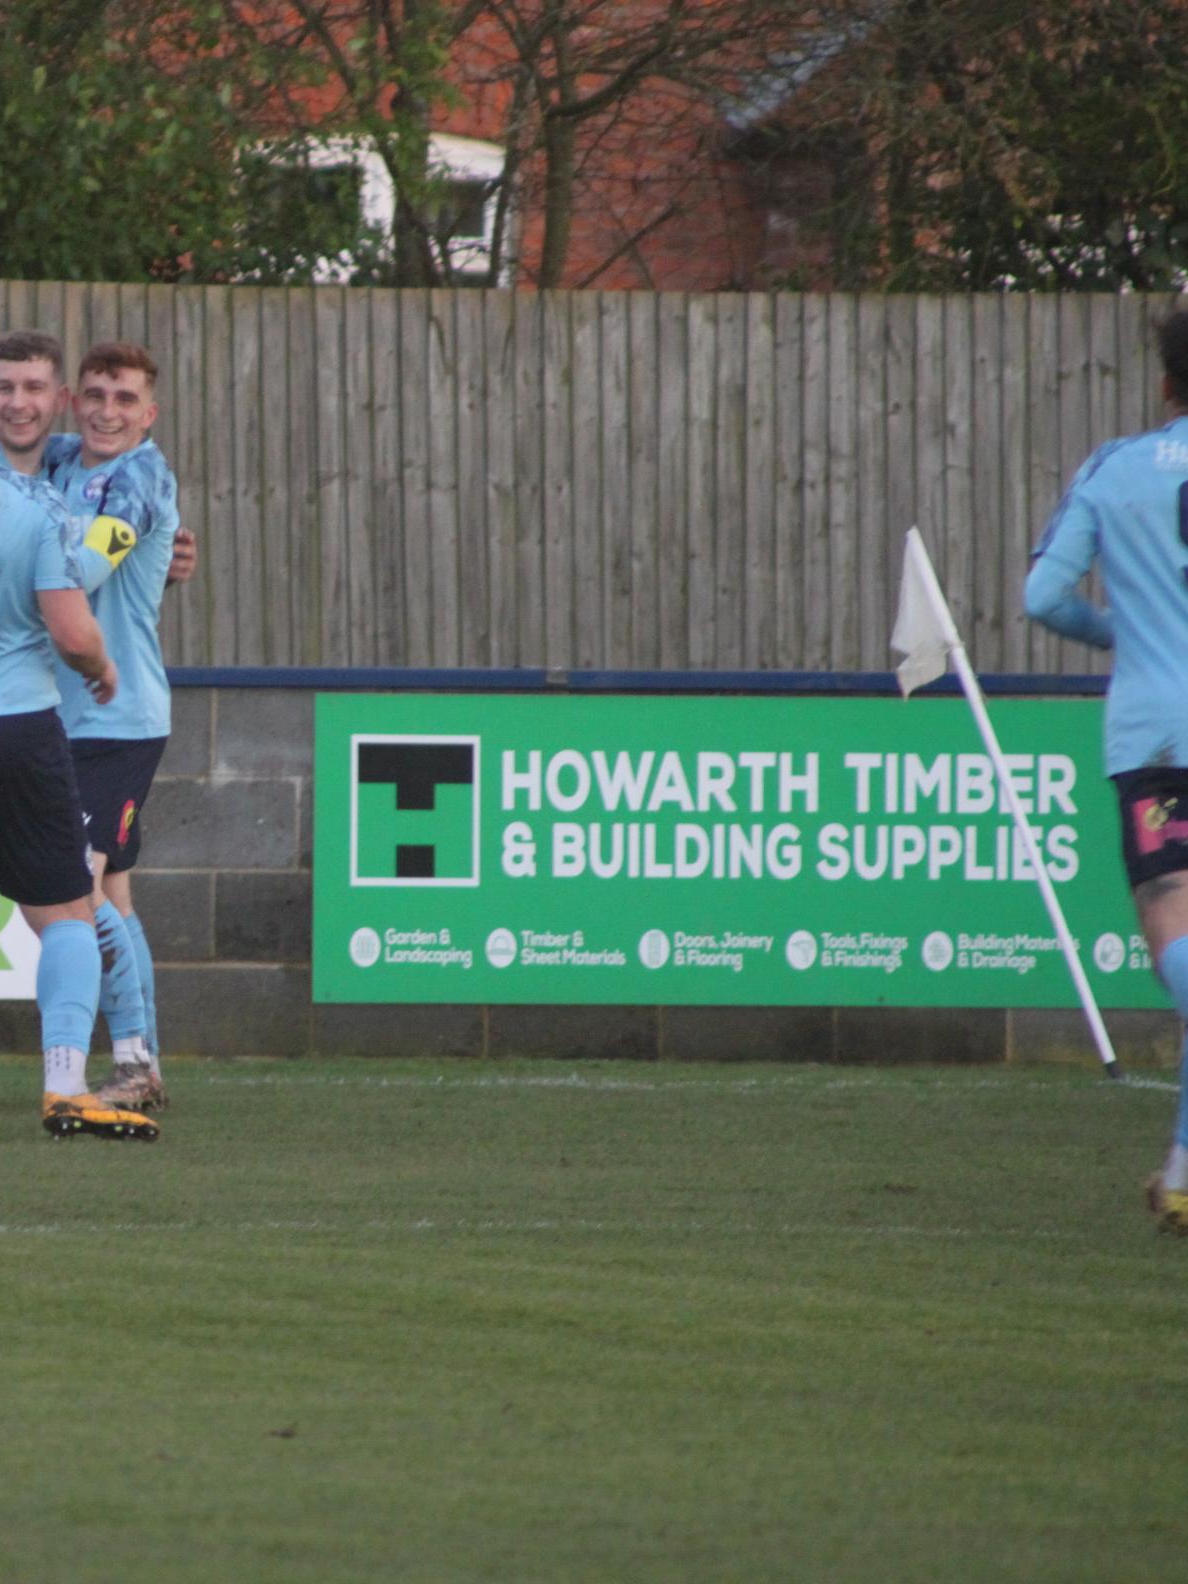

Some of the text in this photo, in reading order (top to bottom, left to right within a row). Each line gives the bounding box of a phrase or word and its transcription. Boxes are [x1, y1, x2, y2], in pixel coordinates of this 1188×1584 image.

[501, 749, 1078, 814] HOWARTH TIMBER
[501, 821, 1080, 882] & BUILDING SUPPLIES
[384, 928, 451, 945] Garden &
[521, 930, 584, 947] Timber &
[720, 932, 774, 953] Joinery
[859, 932, 909, 955] Fixings
[958, 934, 1015, 956] Building
[384, 946, 473, 969] Landscaping
[520, 949, 627, 966] Sheet Materials
[673, 950, 744, 973] & Flooring
[820, 951, 903, 974] & Finishings
[957, 952, 1037, 975] & Drainage
